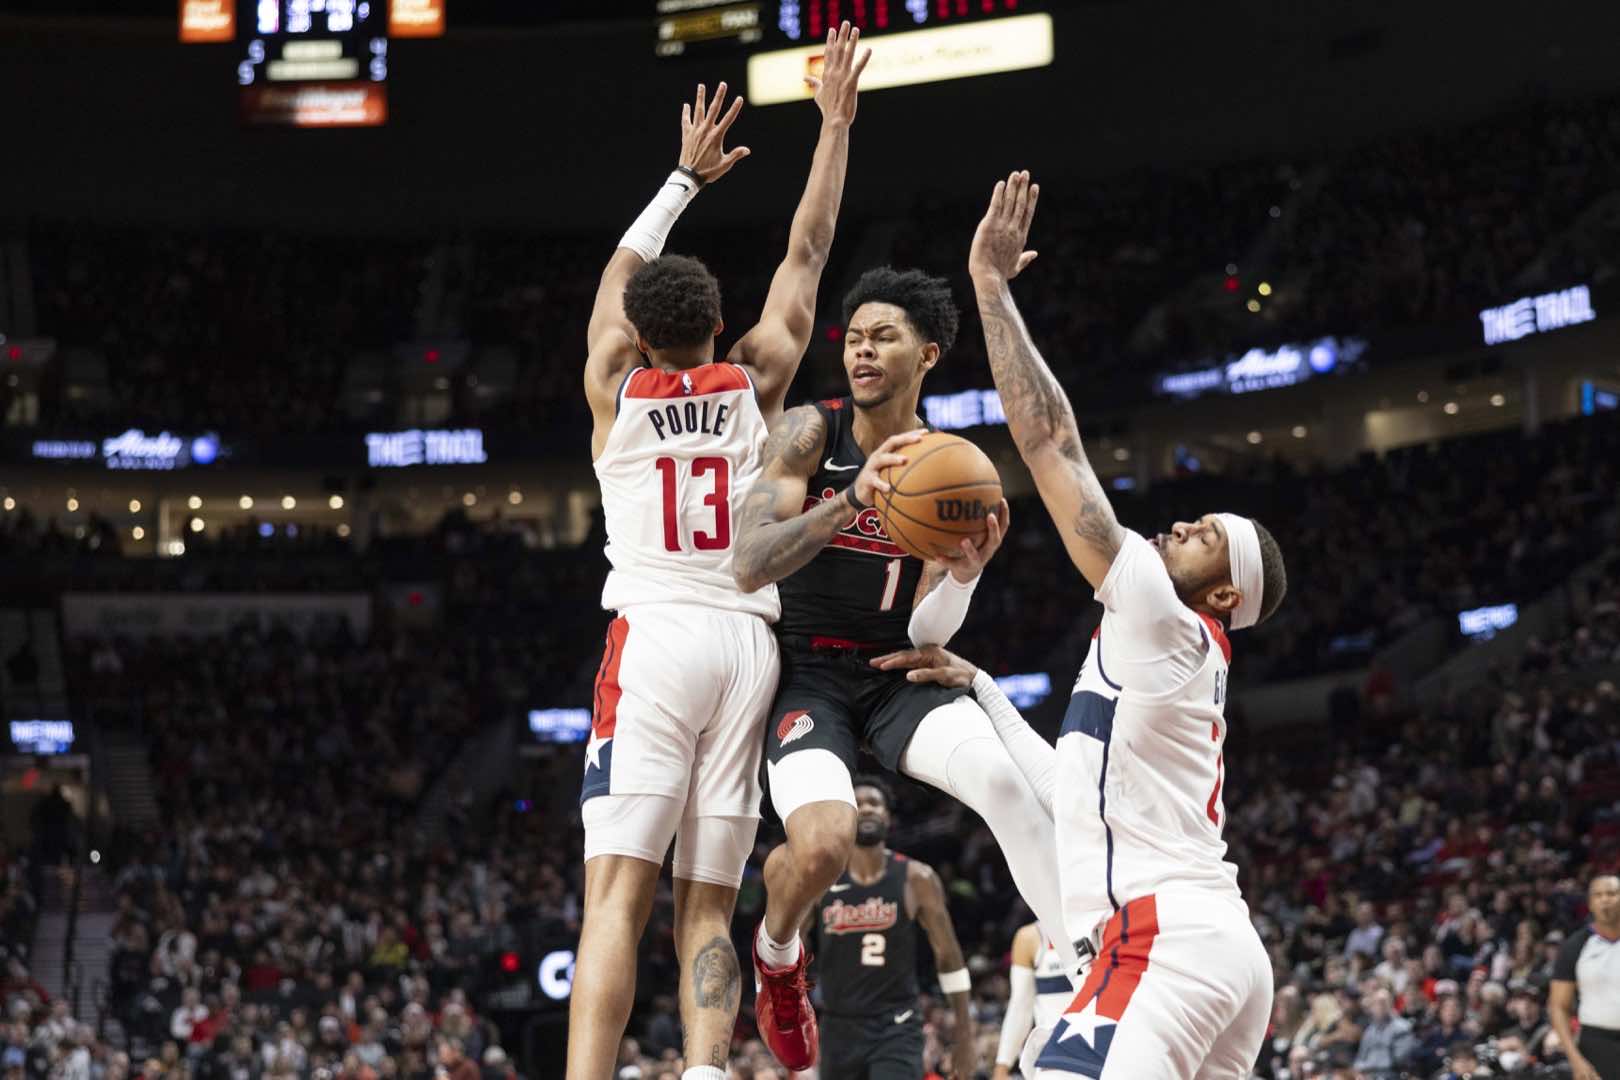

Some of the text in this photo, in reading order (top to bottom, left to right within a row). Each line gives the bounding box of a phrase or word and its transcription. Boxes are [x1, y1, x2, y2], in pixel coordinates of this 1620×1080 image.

[648, 402, 728, 441] POOLE
[655, 457, 731, 552] 13
[879, 559, 904, 612] 1
[861, 933, 886, 966] 2
